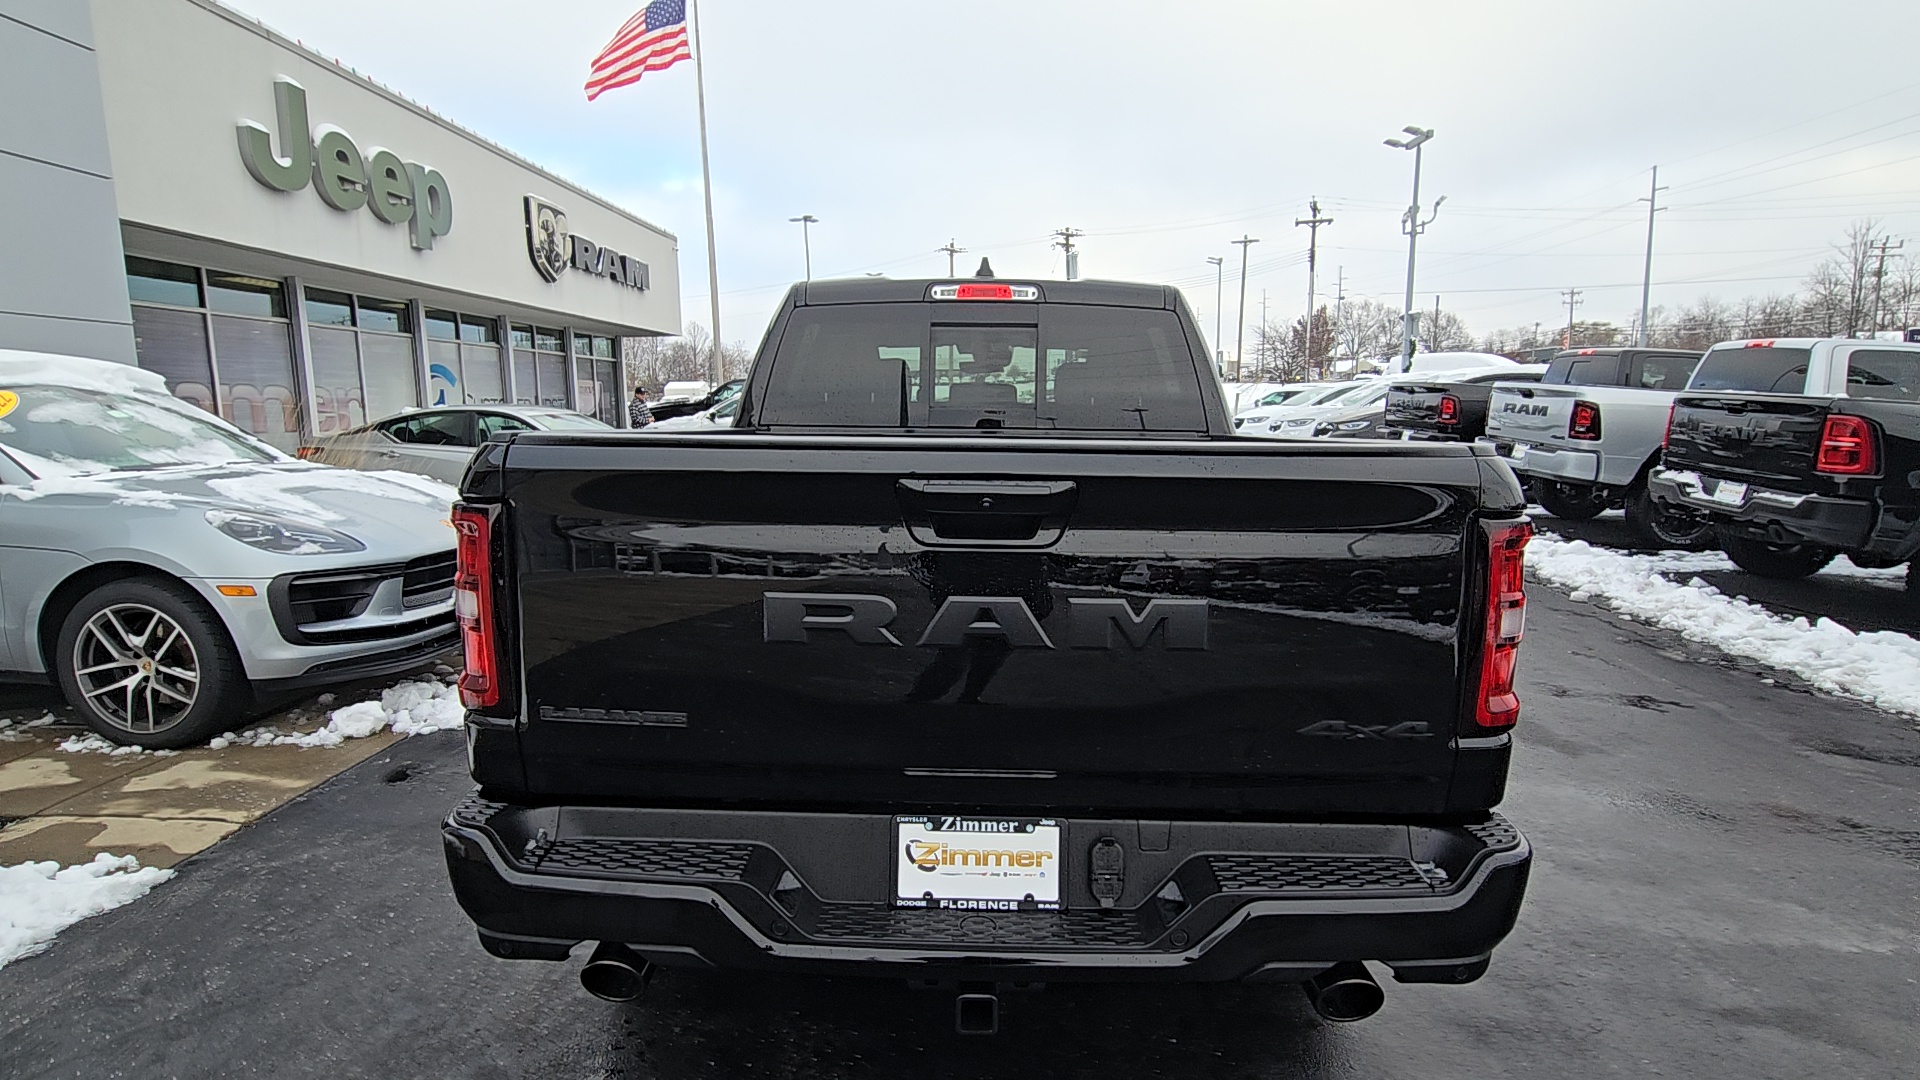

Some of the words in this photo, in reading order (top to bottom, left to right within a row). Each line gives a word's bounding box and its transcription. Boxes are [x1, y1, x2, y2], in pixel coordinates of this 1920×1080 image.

[236, 76, 453, 250] Jeep
[568, 233, 652, 293] RAM
[1502, 402, 1549, 417] RAM
[1697, 422, 1767, 443] RAM
[763, 591, 1210, 651] RAM
[940, 815, 1019, 833] Zimmer
[914, 841, 1054, 868] Zimmer
[939, 900, 1019, 911] FLORENCE
